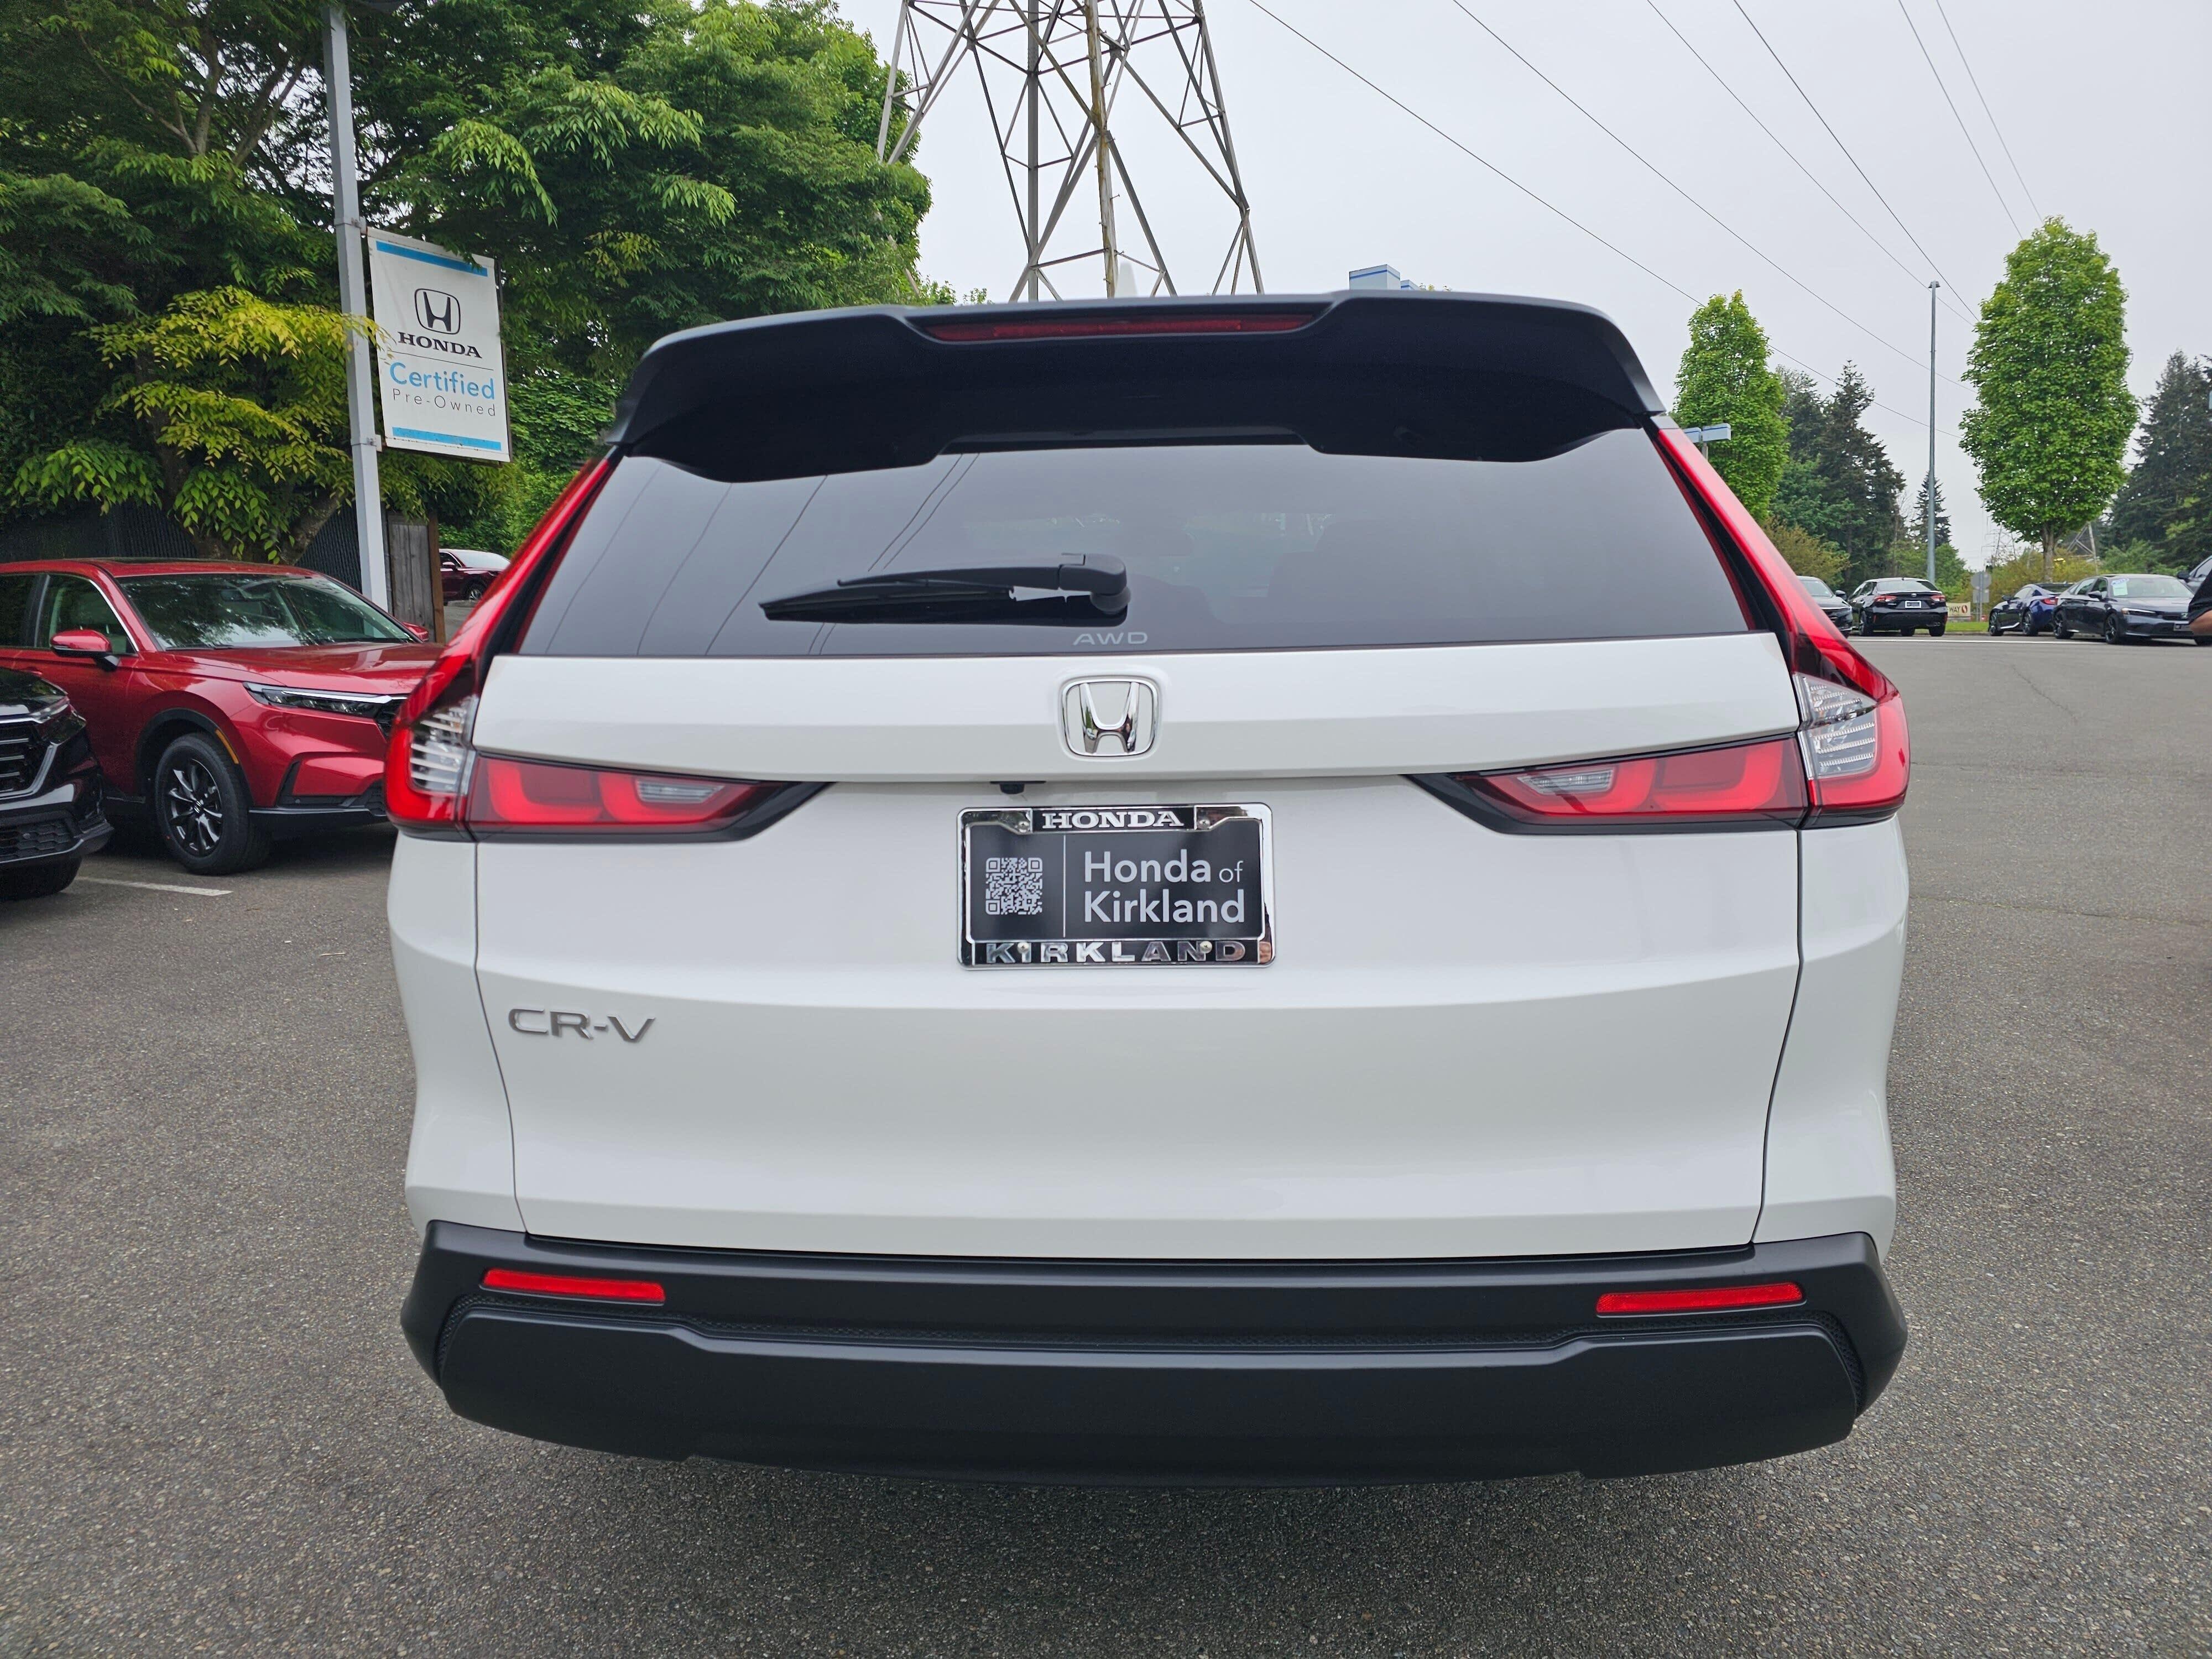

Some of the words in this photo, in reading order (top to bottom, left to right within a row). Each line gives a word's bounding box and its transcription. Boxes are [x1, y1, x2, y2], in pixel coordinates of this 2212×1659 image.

[398, 332, 482, 358] HONDA
[390, 362, 495, 399] Certified
[393, 389, 495, 416] Pre-Owned
[1073, 632, 1148, 645] AWD
[1042, 811, 1184, 829] HONDA
[1084, 849, 1211, 883] Honda
[1219, 860, 1244, 883] of
[1084, 889, 1245, 923] Kirkland
[986, 942, 1246, 963] KIRKLAND
[508, 1008, 656, 1043] CR-V
